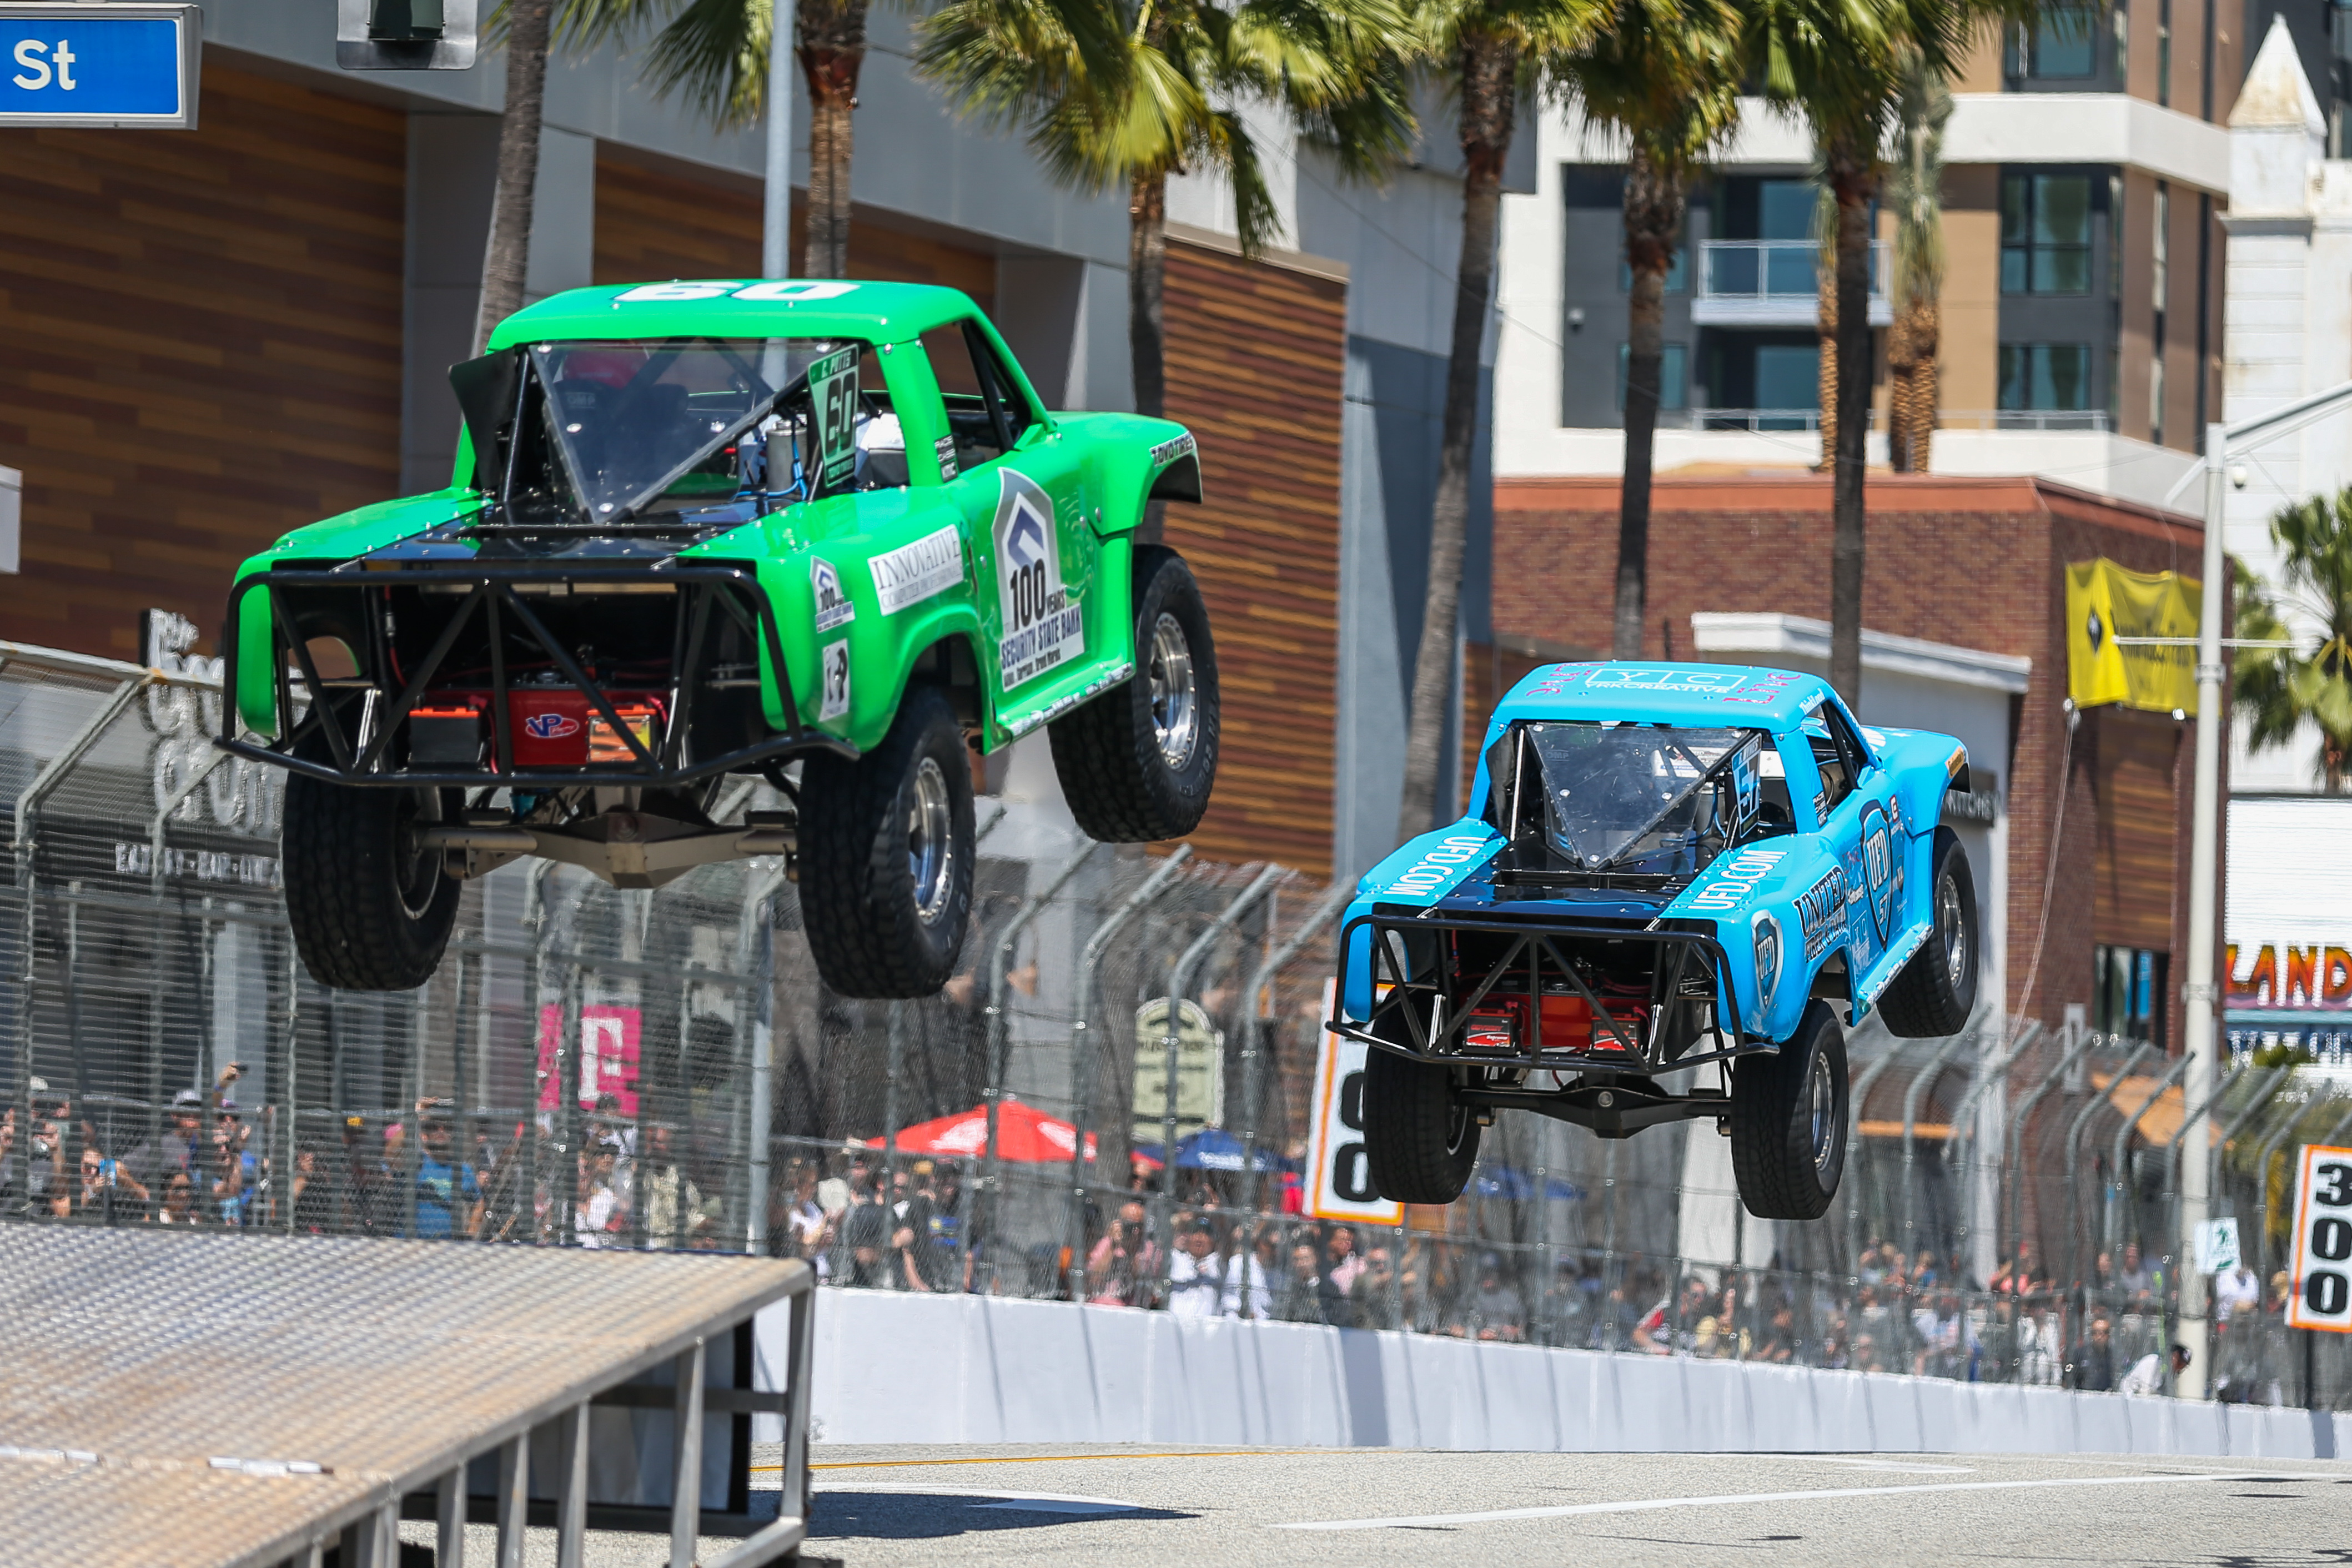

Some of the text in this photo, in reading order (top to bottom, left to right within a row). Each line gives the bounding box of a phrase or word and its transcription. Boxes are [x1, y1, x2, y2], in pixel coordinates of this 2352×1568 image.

[12, 39, 77, 91] St
[612, 281, 861, 301] 60
[825, 370, 856, 459] 60
[871, 527, 961, 591] INNOVATIVE
[1009, 557, 1046, 632] 100
[1001, 626, 1037, 670] SECURITY
[1038, 614, 1060, 651] STATE
[1061, 605, 1082, 640] BANK
[526, 713, 564, 738] VP
[1546, 751, 1569, 760] OMP
[1382, 836, 1488, 897] UFD.COM
[1687, 850, 1788, 910] UFD.COM
[1866, 827, 1888, 892] UFD
[1792, 865, 1846, 938] UNITED
[1879, 893, 1888, 926] 57
[1756, 935, 1775, 981] UFD
[2307, 1164, 2352, 1314] 300
